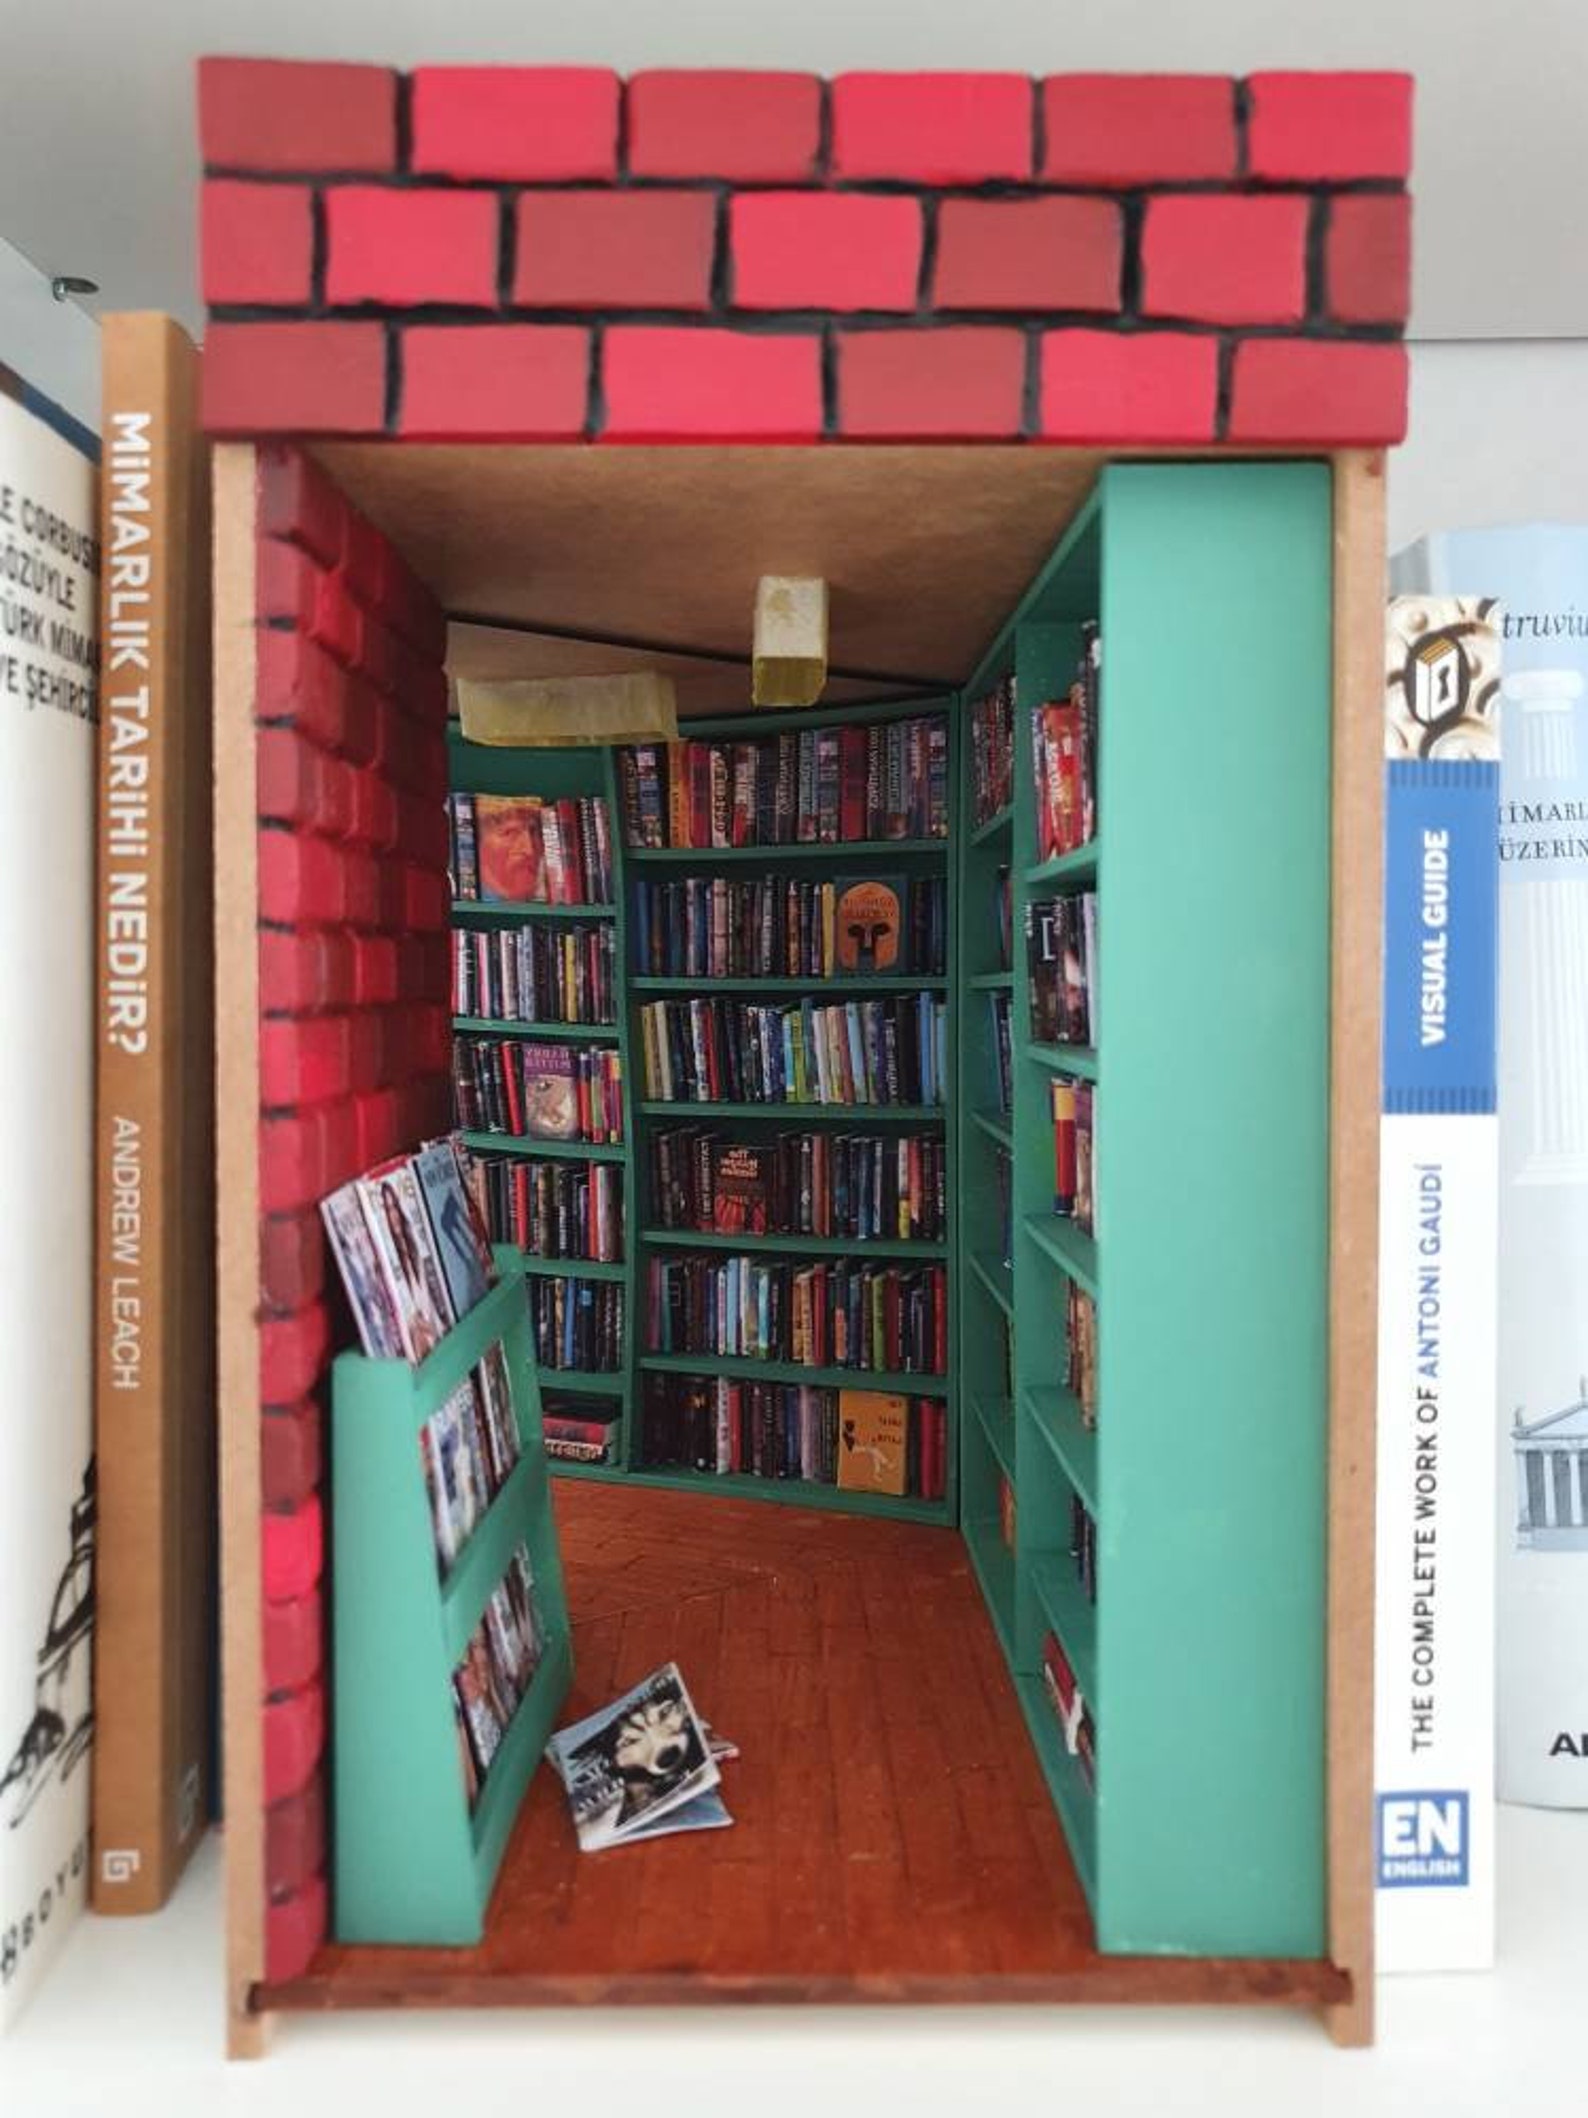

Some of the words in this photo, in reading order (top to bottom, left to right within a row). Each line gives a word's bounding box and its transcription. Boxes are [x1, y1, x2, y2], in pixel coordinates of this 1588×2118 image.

[0, 535, 76, 611] ÖZÜYLE
[110, 413, 150, 671] MİMARLIK
[109, 686, 150, 857] TARİHİ
[1422, 829, 1449, 928] GUIDE
[108, 873, 148, 1054] NEDİR?
[1421, 931, 1447, 1047] VISUAL
[112, 1116, 141, 1266] ANDREW
[1413, 1163, 1442, 1256] GAUDÍ
[112, 1277, 141, 1390] LEACH
[1417, 1266, 1442, 1379] ANTONI
[1416, 1386, 1439, 1424] OF
[1415, 1434, 1438, 1521] WORK
[1412, 1528, 1436, 1686] COMPLETE
[1411, 1696, 1434, 1754] THE
[1383, 1800, 1460, 1856] EN
[1383, 1859, 1461, 1879] ENGLISH
